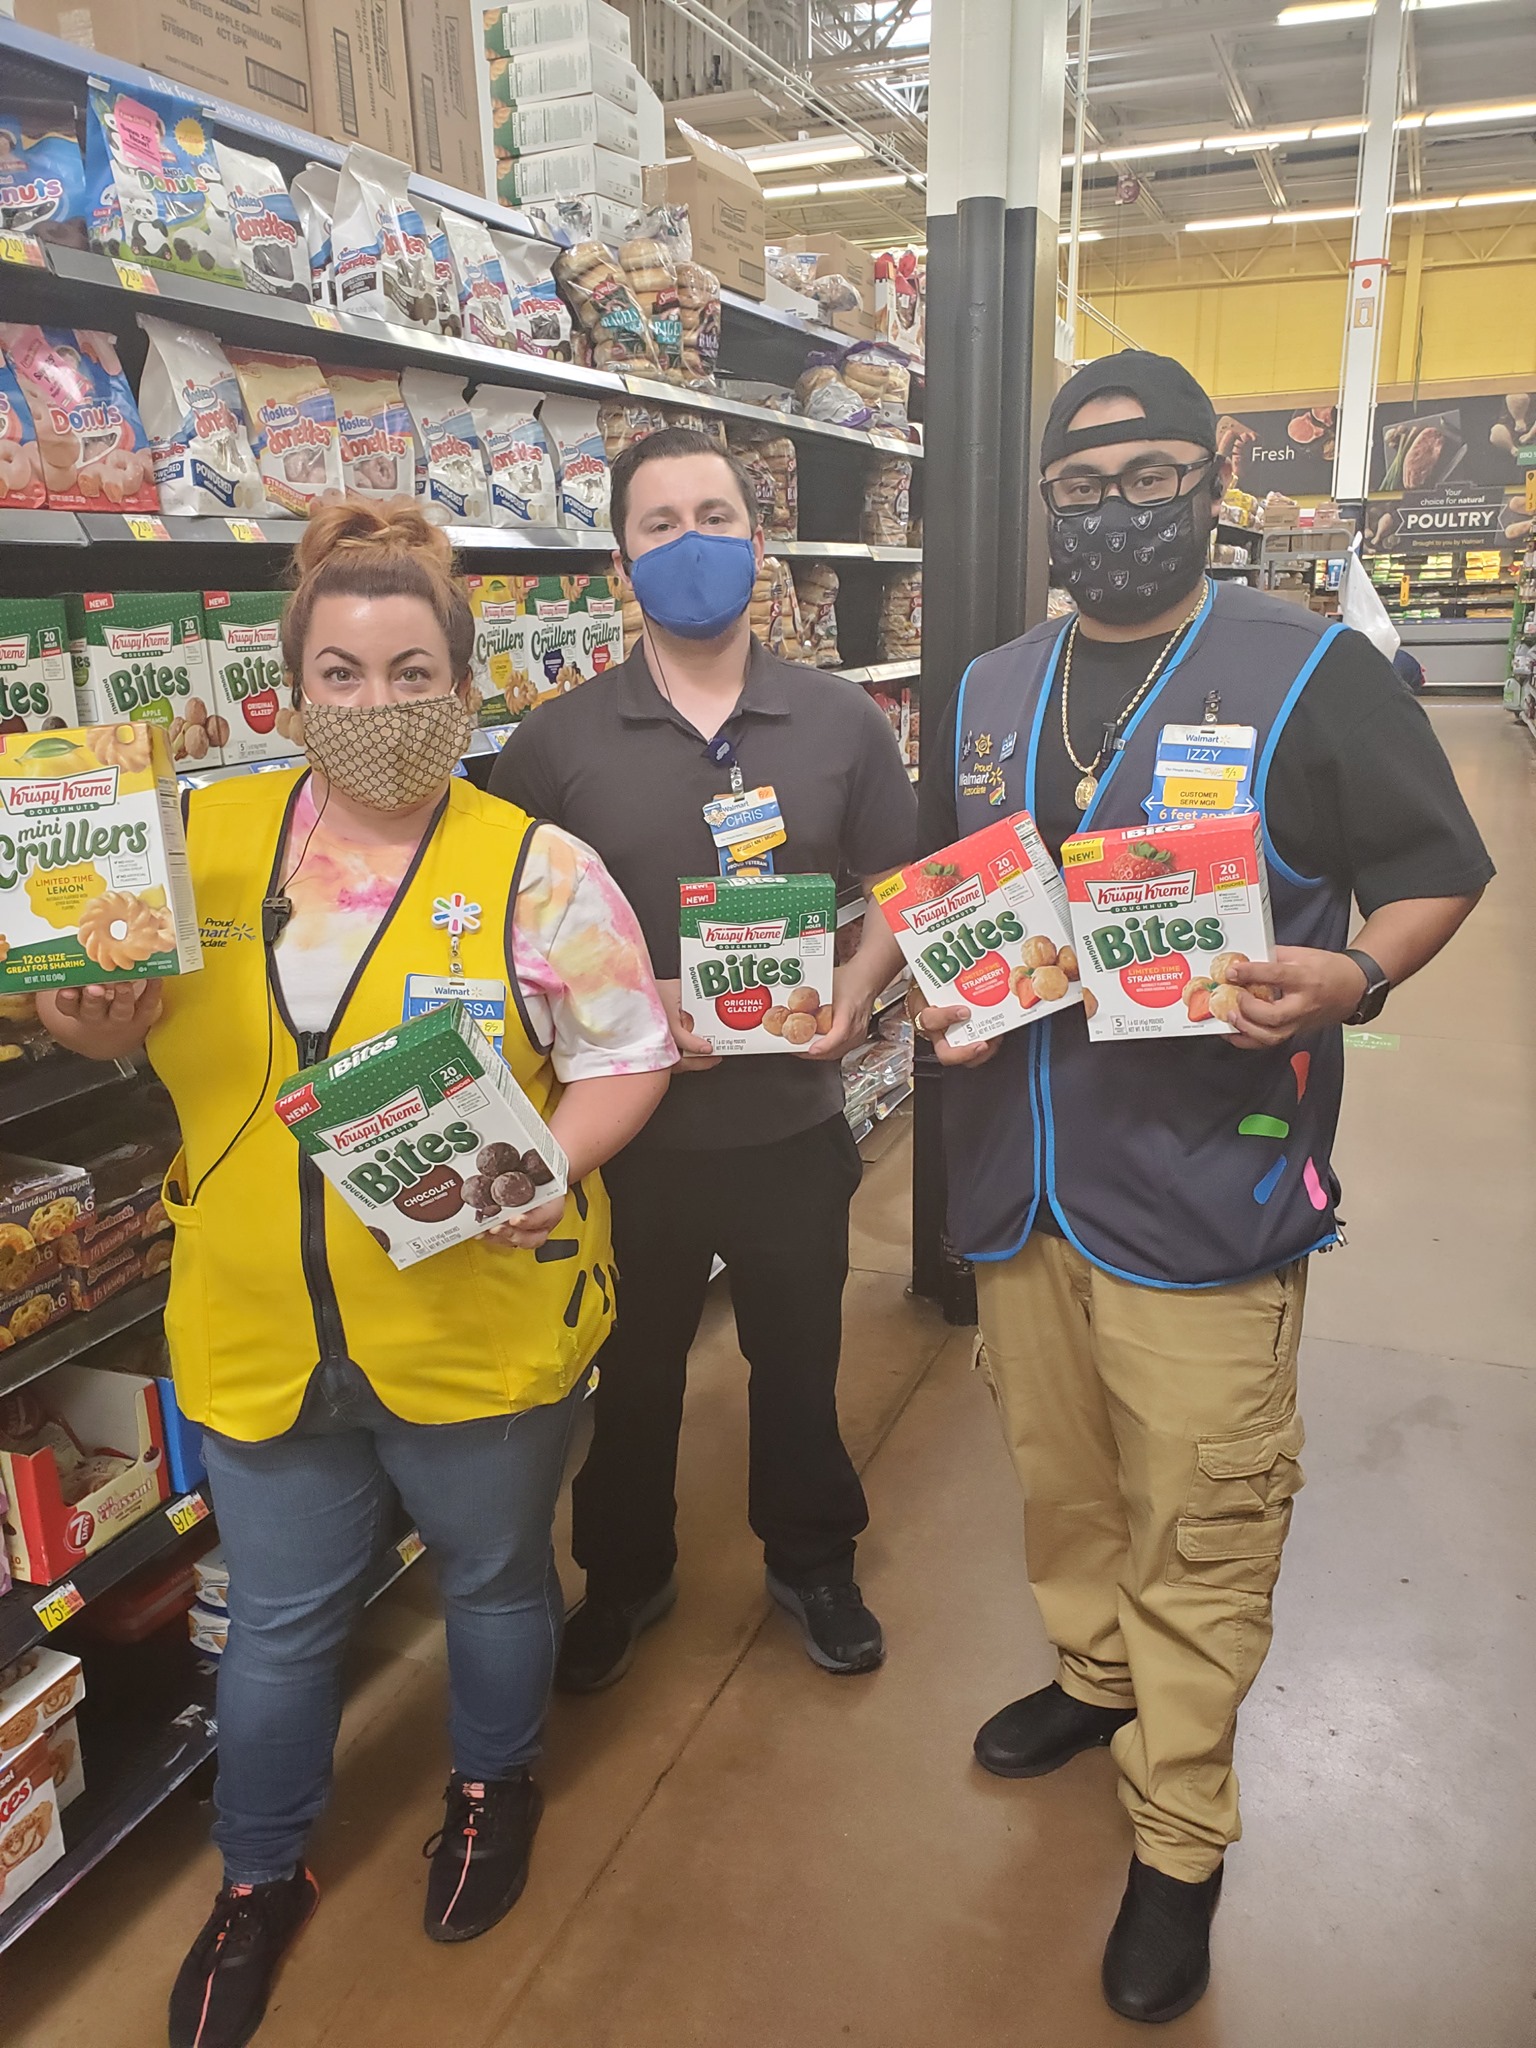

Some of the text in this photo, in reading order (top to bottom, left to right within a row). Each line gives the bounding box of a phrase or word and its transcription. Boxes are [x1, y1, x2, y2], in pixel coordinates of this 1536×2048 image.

[215, 11, 241, 31] APPLE
[241, 23, 282, 50] CINNAMON
[138, 170, 208, 193] Donuts
[0, 178, 62, 204] nuts
[236, 209, 297, 245] donettes
[182, 386, 215, 403] Hostess
[50, 402, 122, 434] Donuts
[261, 405, 298, 423] Hostess
[337, 416, 371, 432] Hostess
[266, 417, 332, 455] donettes
[340, 430, 406, 463] donettes
[1252, 445, 1295, 462] Fresh
[195, 462, 233, 495] POWDERED
[266, 479, 307, 502] STRAWBERRY
[495, 487, 526, 511] POWDERED
[1444, 488, 1462, 496] Your
[564, 496, 593, 518] POWDERED
[1420, 496, 1485, 506] choice for natural
[1407, 511, 1494, 529] POULTRY
[89, 599, 109, 609] NEW!
[208, 596, 226, 607] NEW!
[184, 620, 195, 630] 20
[44, 631, 56, 643] 20
[112, 631, 170, 651] Krispy Kreme
[227, 628, 277, 646] Krispy Kreme
[476, 627, 524, 664] Crullers
[531, 625, 576, 661] Crullers
[582, 622, 620, 655] Crullers
[0, 644, 25, 660] reme
[108, 662, 191, 712] Bites
[0, 677, 50, 719] tes
[103, 678, 119, 715] DOUGHNUT
[142, 709, 162, 717] APPLE
[247, 702, 274, 710] ORIGINAL
[1186, 734, 1219, 743] Walmart
[1186, 748, 1222, 761] IZZY
[974, 762, 993, 773] Proud
[959, 772, 990, 786] Walmart
[9, 777, 113, 806] Krispy Kreme
[963, 785, 987, 796] Associate
[29, 804, 96, 816] DOUGHNUTS
[722, 801, 750, 813] Walmart
[1159, 809, 1199, 820] 6 feet
[725, 809, 763, 827] CHRIS
[18, 816, 62, 843] mini
[1127, 823, 1196, 839] Bites
[1067, 839, 1096, 847] NEW!
[745, 859, 768, 867] VETERAN
[995, 857, 1010, 871] 20
[1069, 851, 1094, 863] NEW!
[999, 865, 1015, 877] HOLES
[1219, 873, 1240, 882] HOLES
[1220, 863, 1236, 875] 20
[35, 874, 94, 887] LIMITED TIME
[1221, 881, 1244, 889] POUCHES
[47, 884, 85, 896] LEMON
[879, 883, 900, 899] NEW!
[1098, 879, 1191, 905] Krispy Kreme
[686, 895, 709, 904] NEW!
[913, 883, 981, 929] Krispy Kreme
[1114, 902, 1174, 913] DOUGHNUTS
[205, 917, 235, 927] Proud
[807, 914, 820, 924] 20
[930, 908, 974, 932] DOUGHNUTS
[199, 927, 230, 938] mart
[705, 926, 783, 943] Krispy Kreme
[920, 910, 1024, 985] Bites
[1091, 915, 1224, 970] Bites
[48, 953, 67, 962] SIZE
[1082, 935, 1104, 974] DOUGHNUT
[6, 960, 86, 974] GREAT FOR SHARING
[914, 958, 942, 989] DOUGHNUT
[1128, 967, 1160, 976] LIMITED
[688, 967, 703, 1000] DOUGHNUT
[697, 954, 802, 998] Bites
[962, 967, 1004, 990] STRAWBERRY
[1127, 972, 1184, 984] STRAWBERRY
[434, 986, 470, 996] Walmart
[420, 1001, 495, 1016] JESSA
[966, 1024, 973, 1033] 5
[1115, 1018, 1122, 1027] 5
[334, 1035, 399, 1078] Bites
[440, 1066, 458, 1081] 20
[444, 1073, 464, 1088] HOLES
[279, 1088, 306, 1107] NEW!
[285, 1103, 313, 1122] NEW!
[333, 1097, 423, 1149] Krispy Kreme
[358, 1122, 415, 1151] DOUGHNUTS
[347, 1121, 480, 1205] Bites
[12, 1178, 91, 1214] Individually Wrapped
[340, 1179, 378, 1211] DOUGHNUT
[404, 1179, 457, 1208] CHOCOLATE
[412, 1241, 421, 1250] 5
[70, 1514, 91, 1546] 7 DAYS
